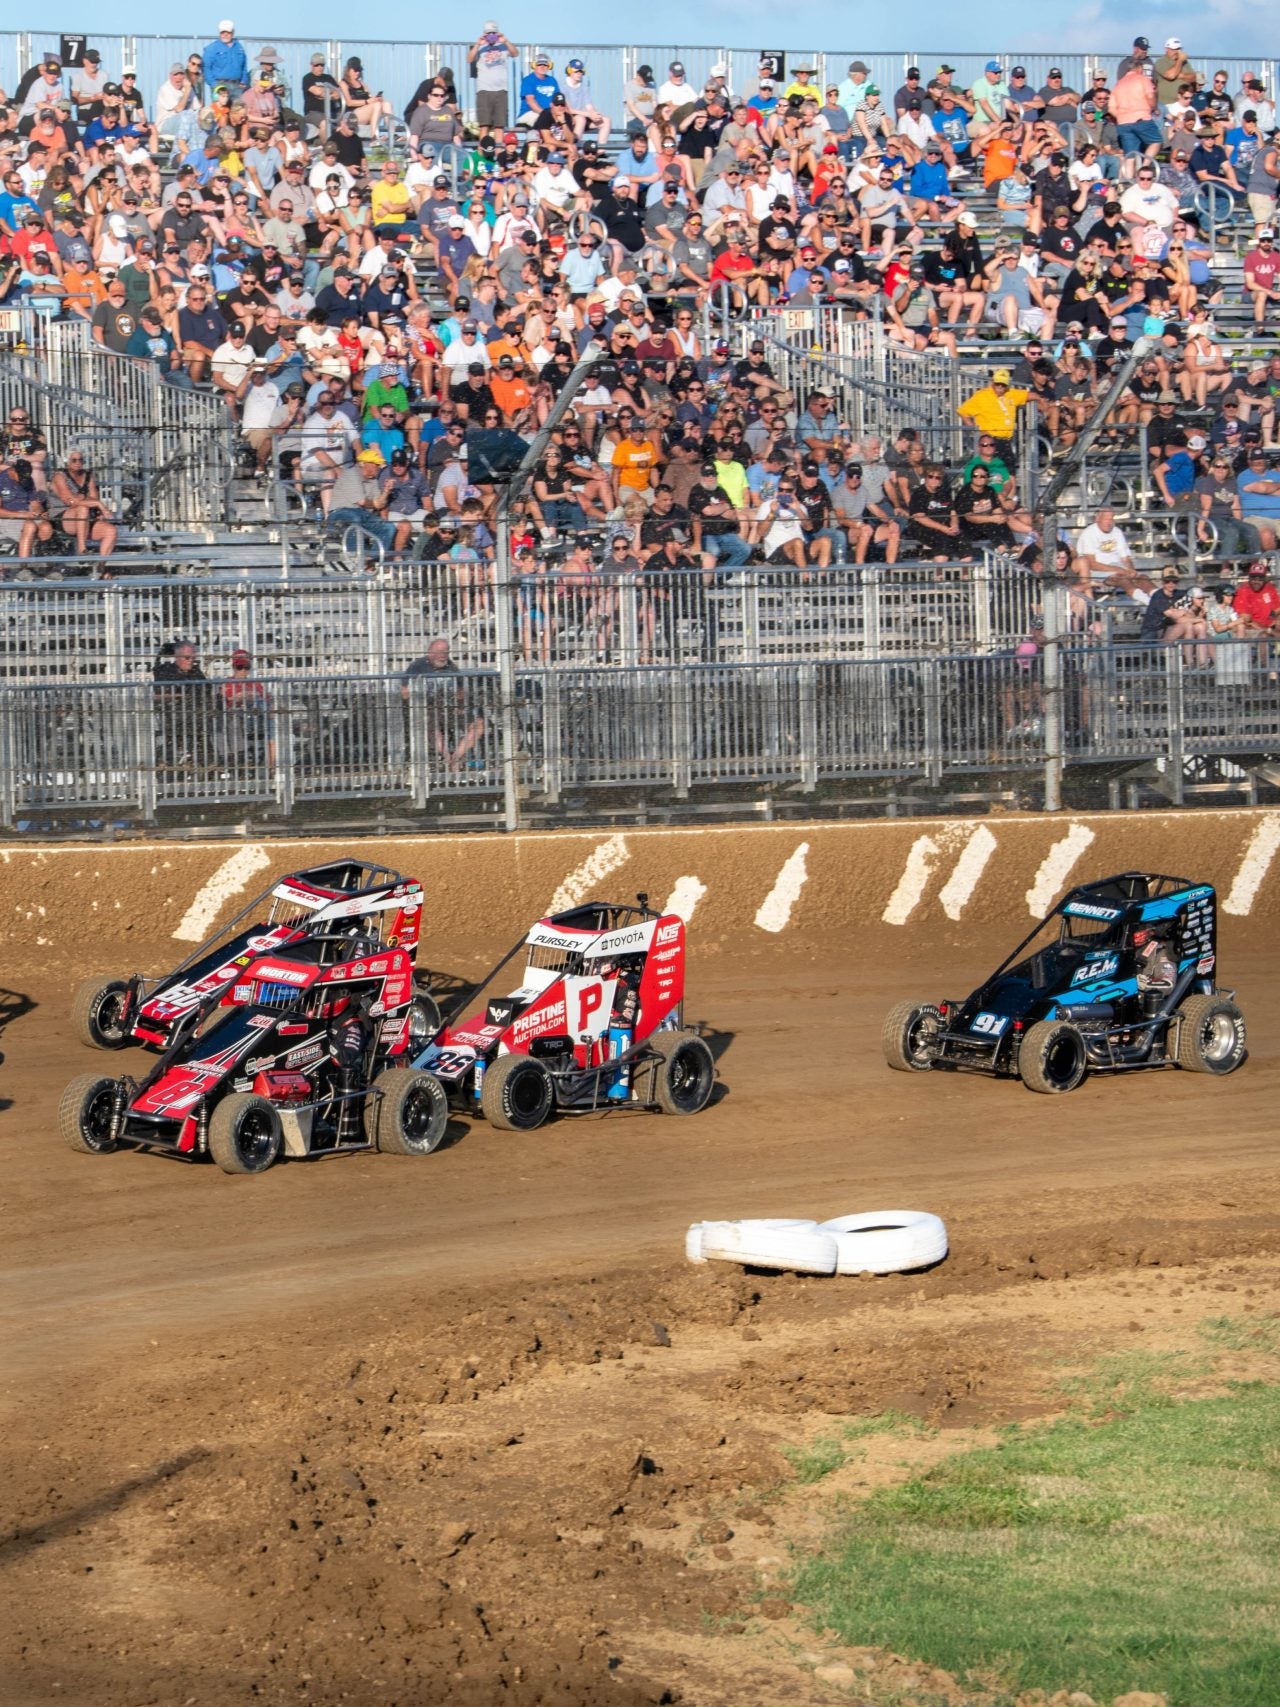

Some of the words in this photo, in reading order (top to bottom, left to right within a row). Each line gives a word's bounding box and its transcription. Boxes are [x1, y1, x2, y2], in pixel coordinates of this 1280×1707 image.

[68, 42, 79, 60] 7
[788, 311, 805, 328] EXIT
[287, 888, 320, 903] WELCH
[1069, 902, 1117, 919] BENNETT
[610, 931, 644, 948] TOYOTA
[656, 922, 682, 943] NOS
[254, 938, 276, 948] BE
[534, 935, 583, 949] PURSLEY
[256, 966, 309, 984] MORTON
[1075, 959, 1118, 981] R.E.M.
[577, 983, 603, 1032] P
[513, 1000, 565, 1035] PRISTINE
[972, 1014, 1007, 1035] 91
[513, 1014, 565, 1046] AUCTION.COM
[1232, 1017, 1245, 1060] Hoosier
[288, 1050, 305, 1061] EAST
[306, 1046, 320, 1056] SIDE
[544, 1040, 564, 1049] TRD
[422, 1050, 474, 1075] 86
